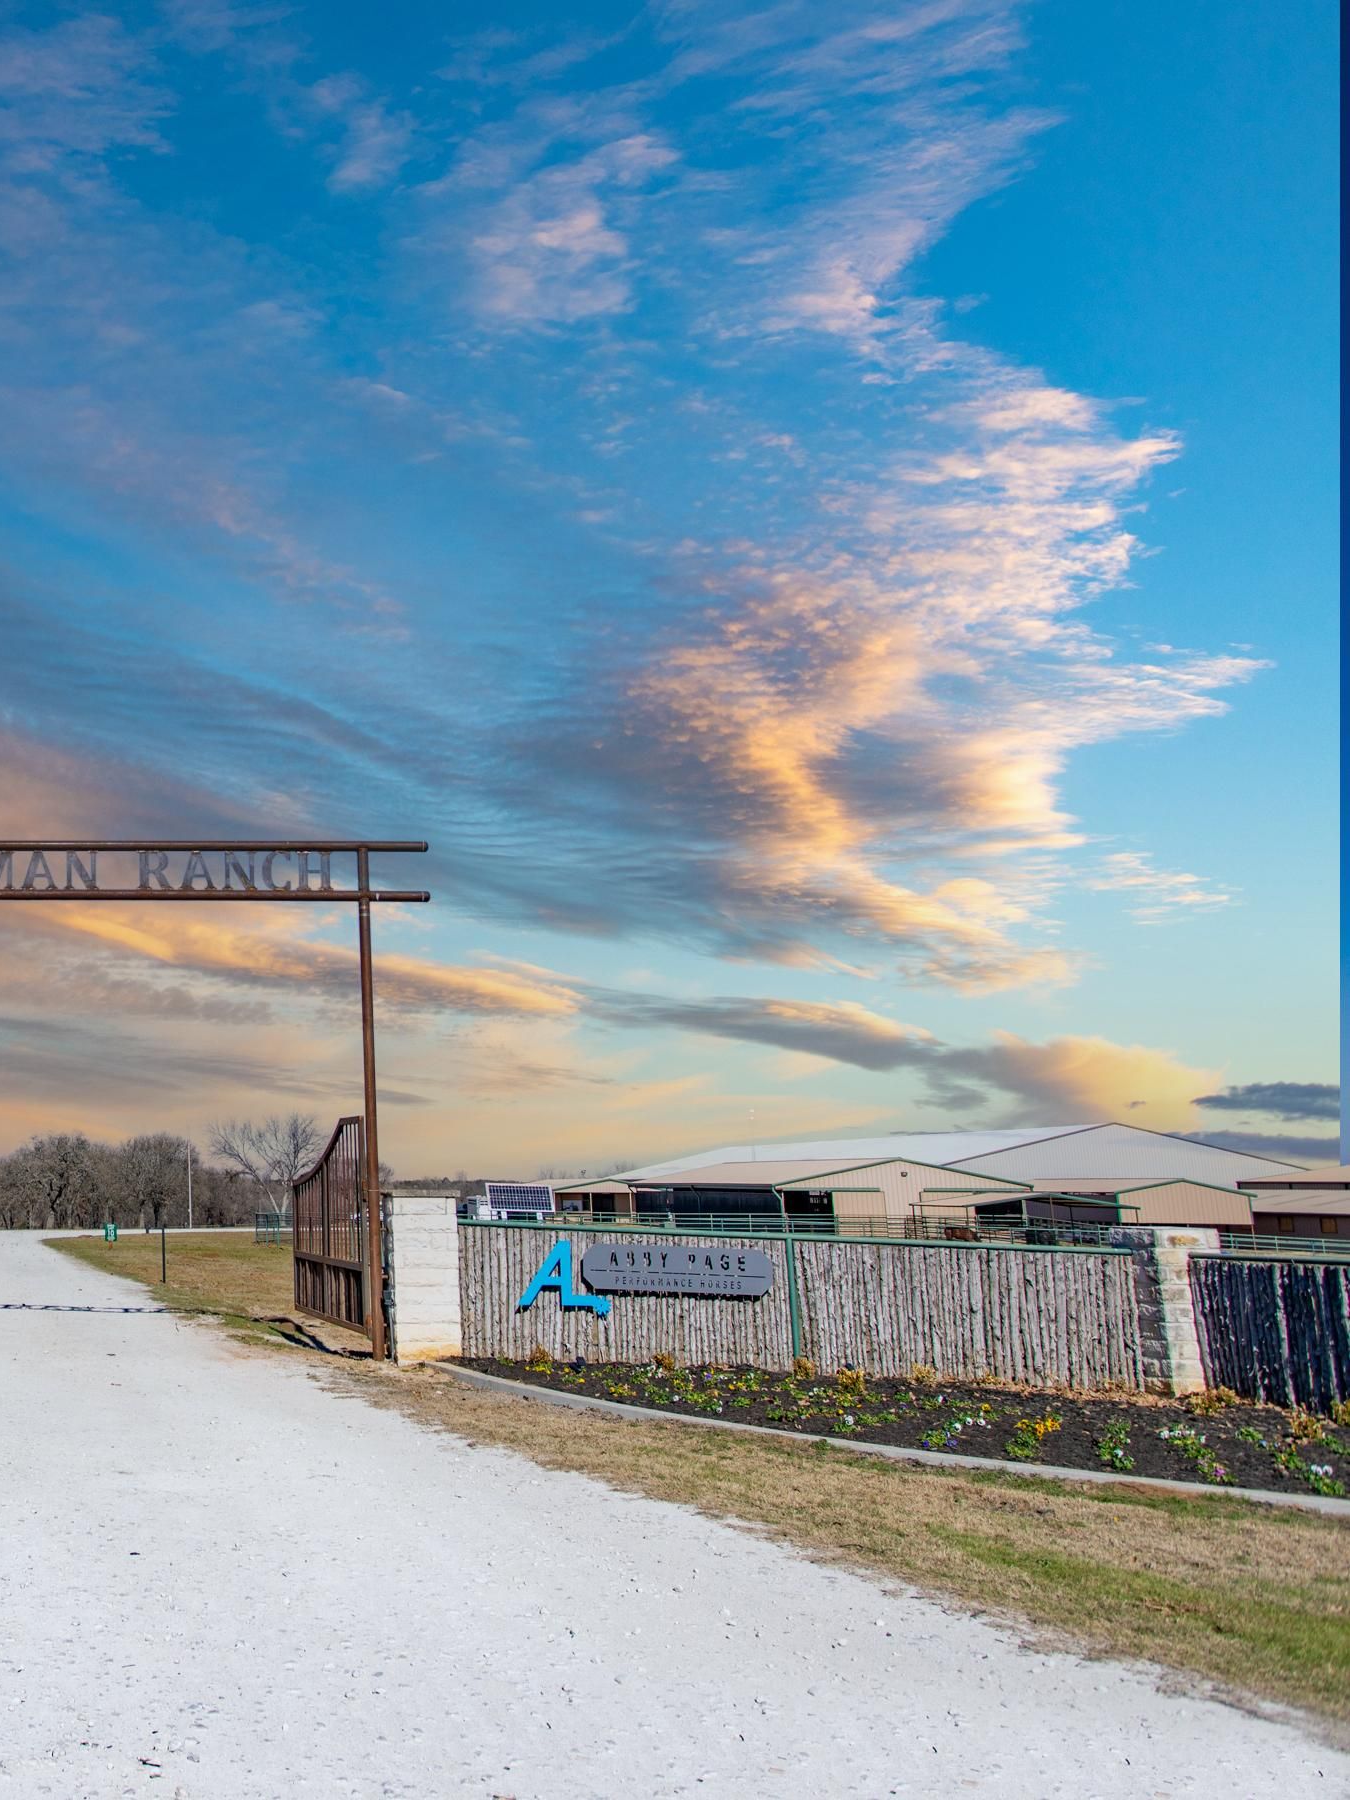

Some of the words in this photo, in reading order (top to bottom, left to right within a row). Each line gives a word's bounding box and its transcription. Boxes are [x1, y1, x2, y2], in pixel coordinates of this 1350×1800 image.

[137, 849, 335, 891] RANCH
[609, 1250, 669, 1269] ABBY
[687, 1252, 747, 1272] PAGE
[614, 1275, 693, 1289] PERFORMANCE
[699, 1277, 743, 1290] HORSES
